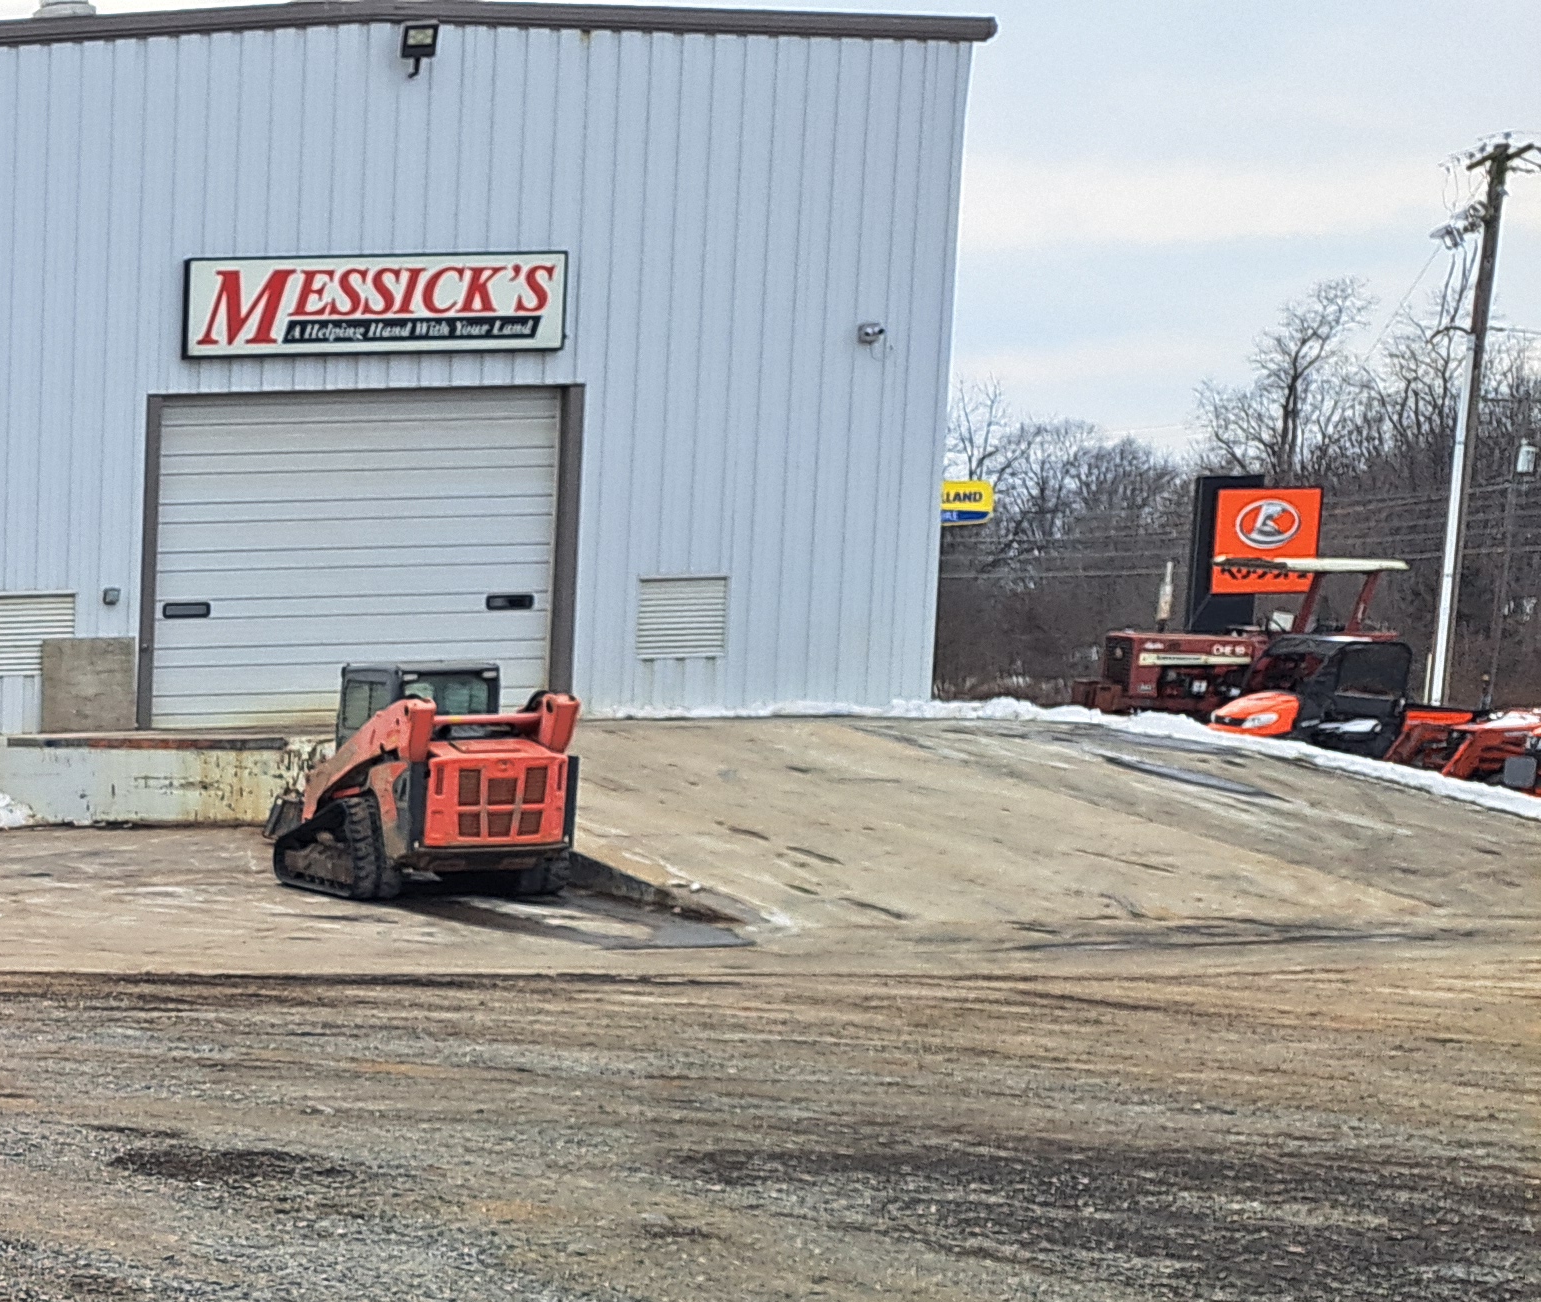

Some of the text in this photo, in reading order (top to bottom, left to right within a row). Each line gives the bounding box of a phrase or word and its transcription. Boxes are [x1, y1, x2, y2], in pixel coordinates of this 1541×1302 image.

[196, 264, 556, 346] MESSICK'S
[287, 318, 534, 342] A Helping Hand With Your Land
